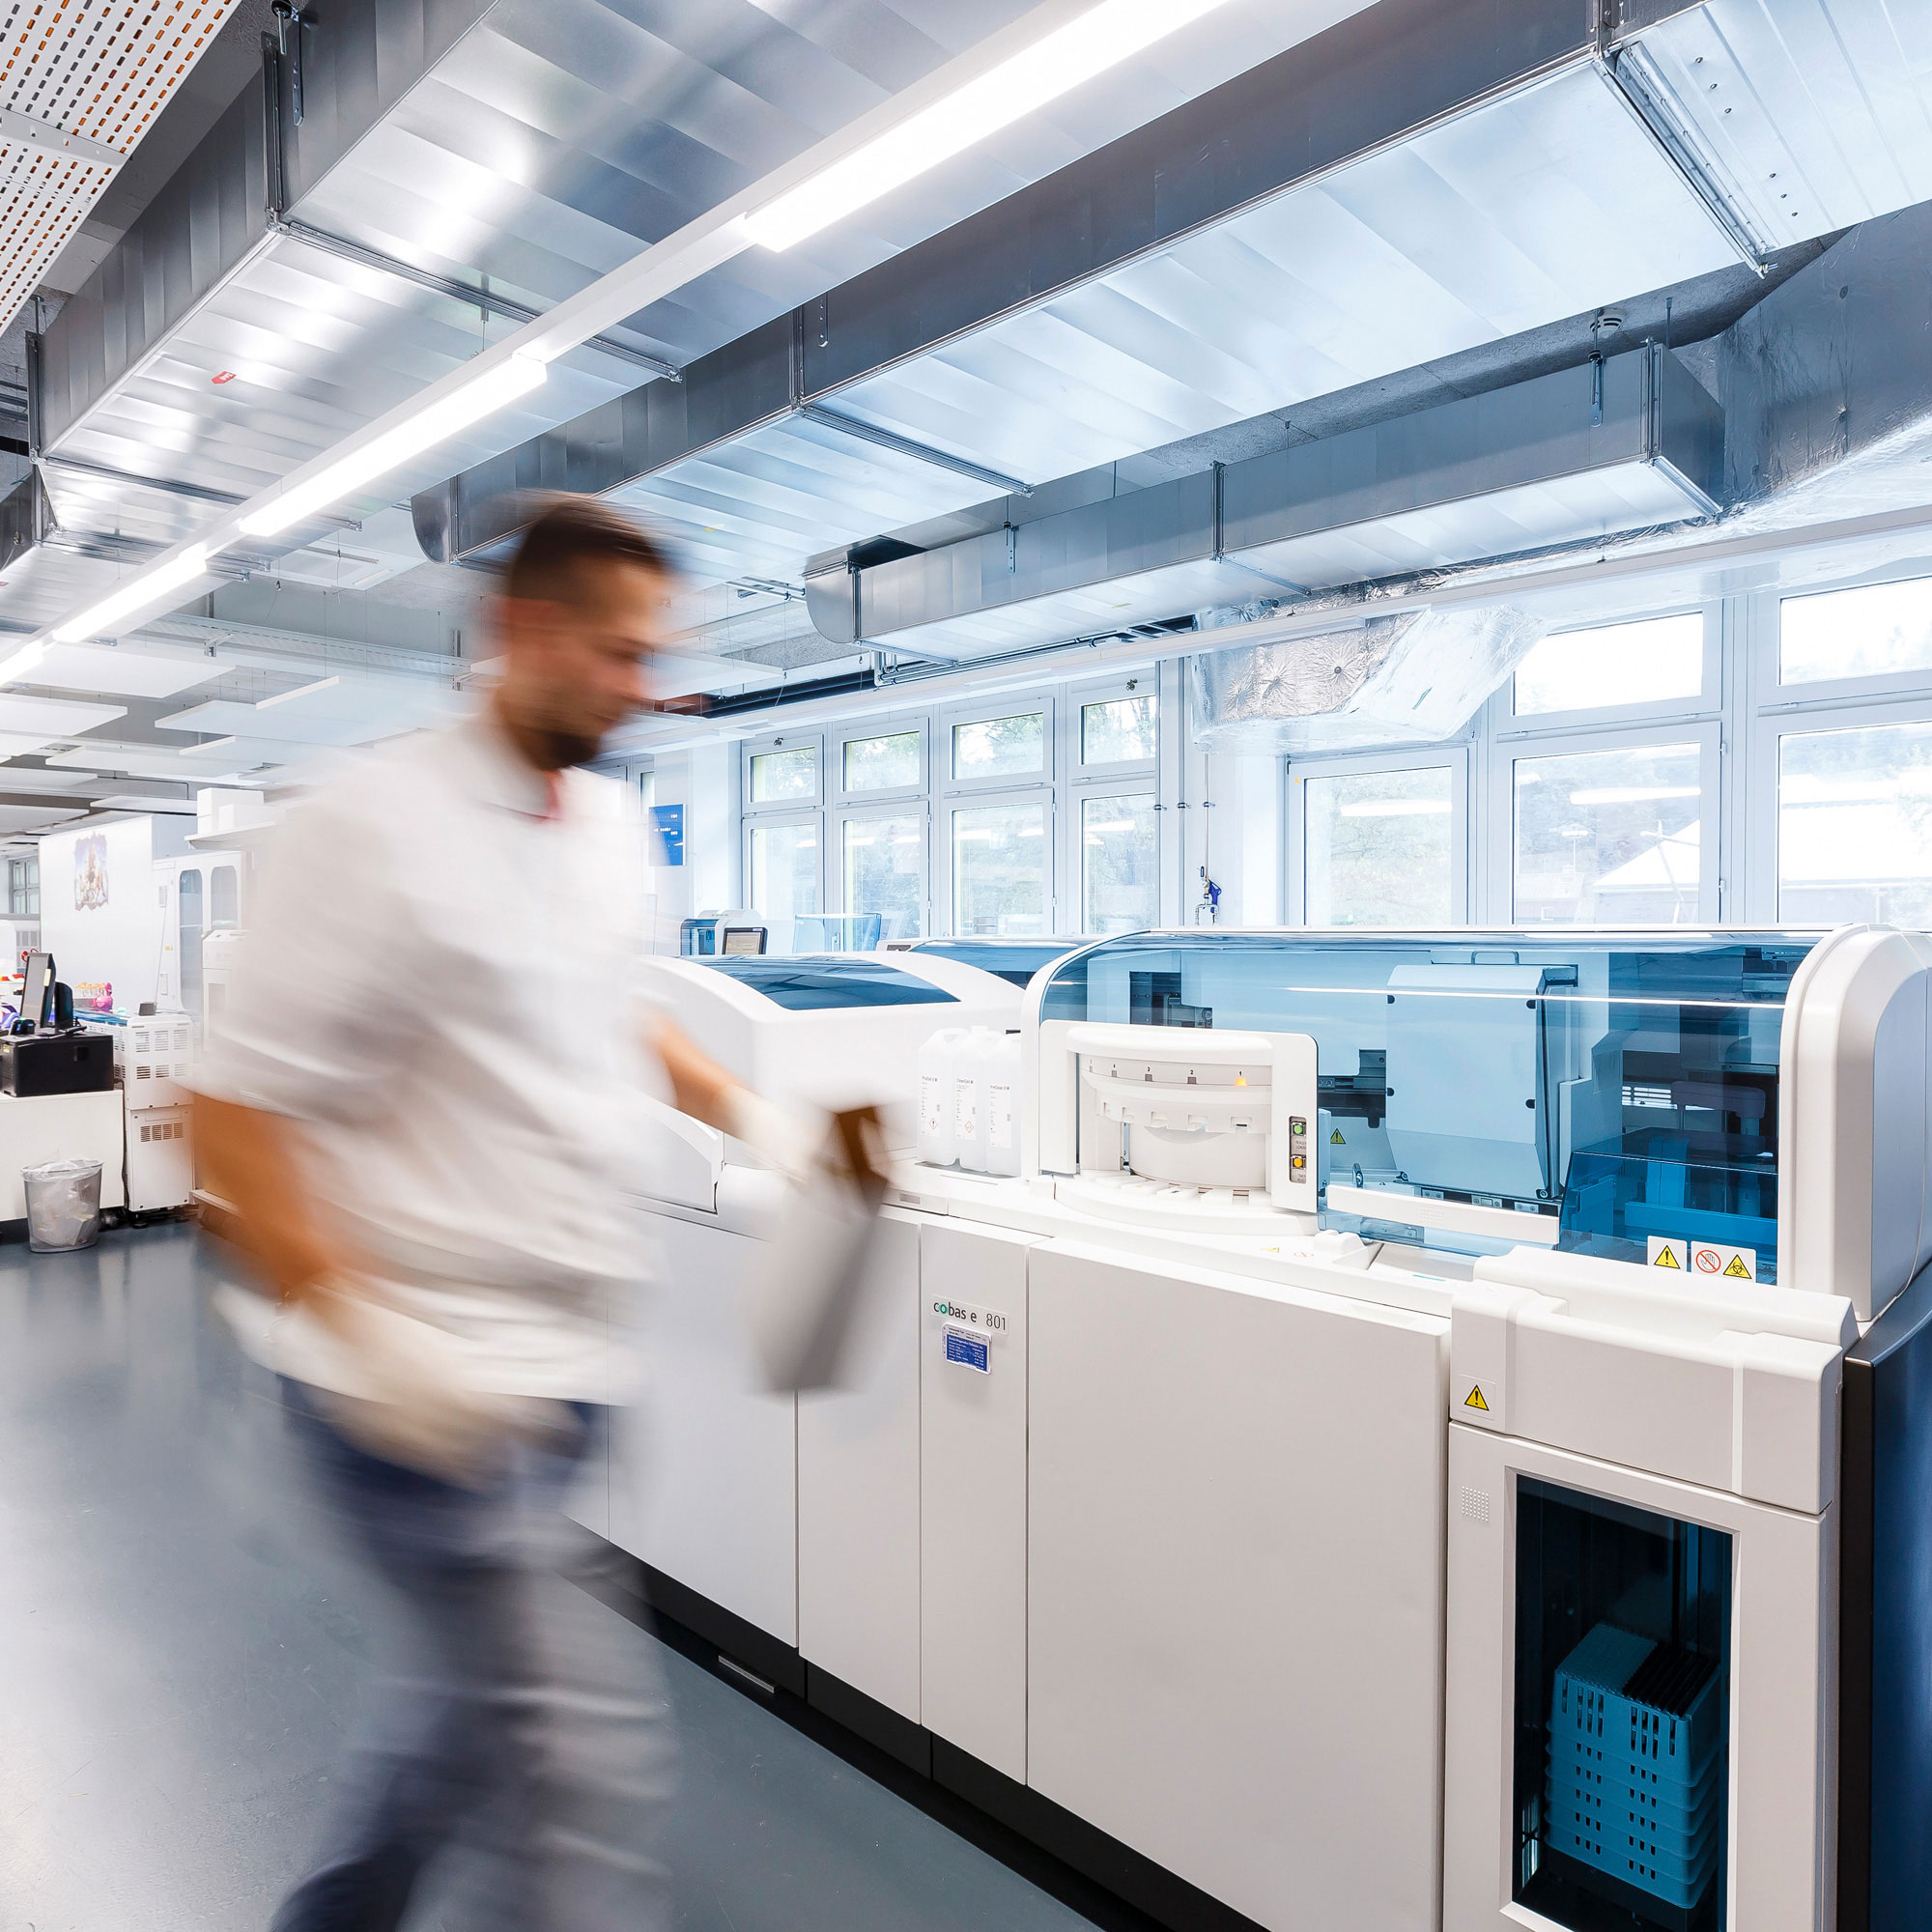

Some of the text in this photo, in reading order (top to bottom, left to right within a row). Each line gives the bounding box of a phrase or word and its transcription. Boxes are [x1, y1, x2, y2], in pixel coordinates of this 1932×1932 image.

[933, 1301, 1006, 1331] cobas e 801
